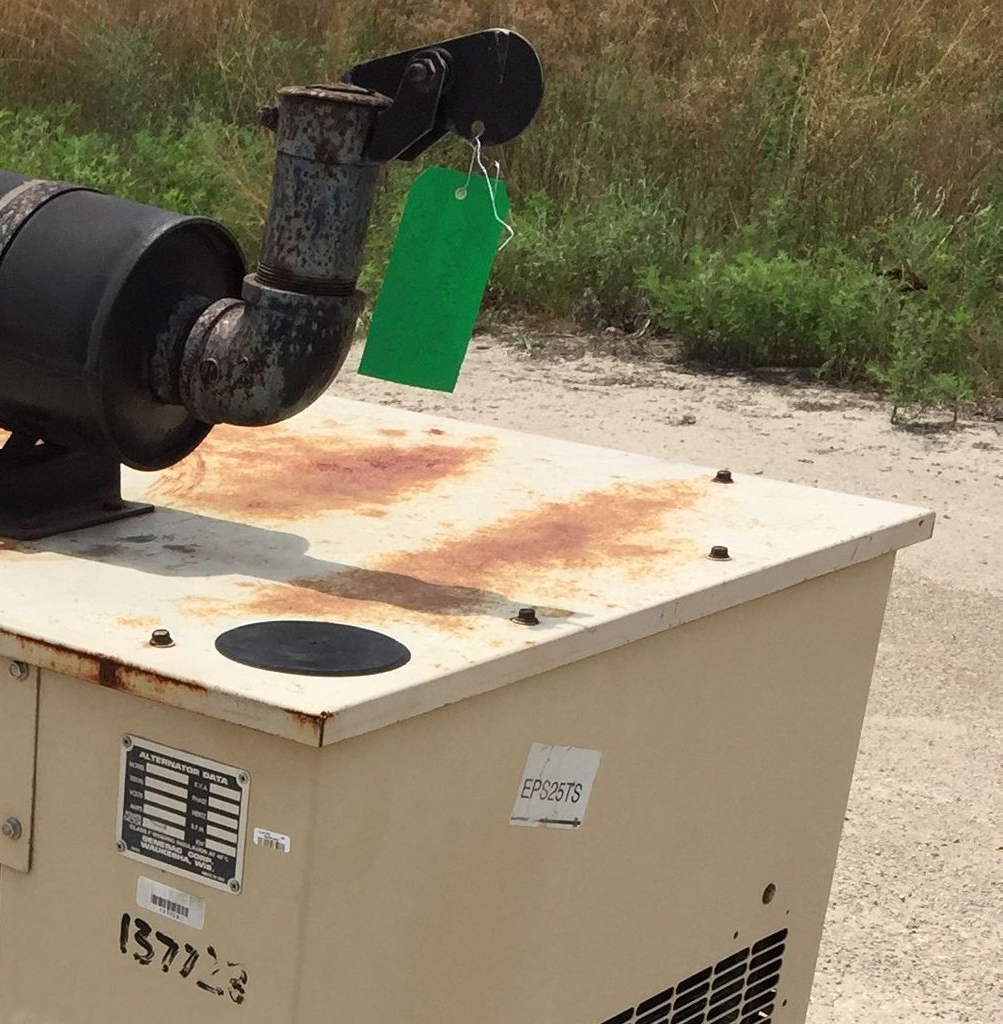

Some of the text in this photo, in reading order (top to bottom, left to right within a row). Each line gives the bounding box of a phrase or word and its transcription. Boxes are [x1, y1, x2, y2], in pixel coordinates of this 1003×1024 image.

[139, 751, 229, 785] ALTERNATOR DATA
[520, 778, 583, 803] EPS25TS
[141, 835, 183, 854] GENERAC
[187, 851, 214, 865] CORP.
